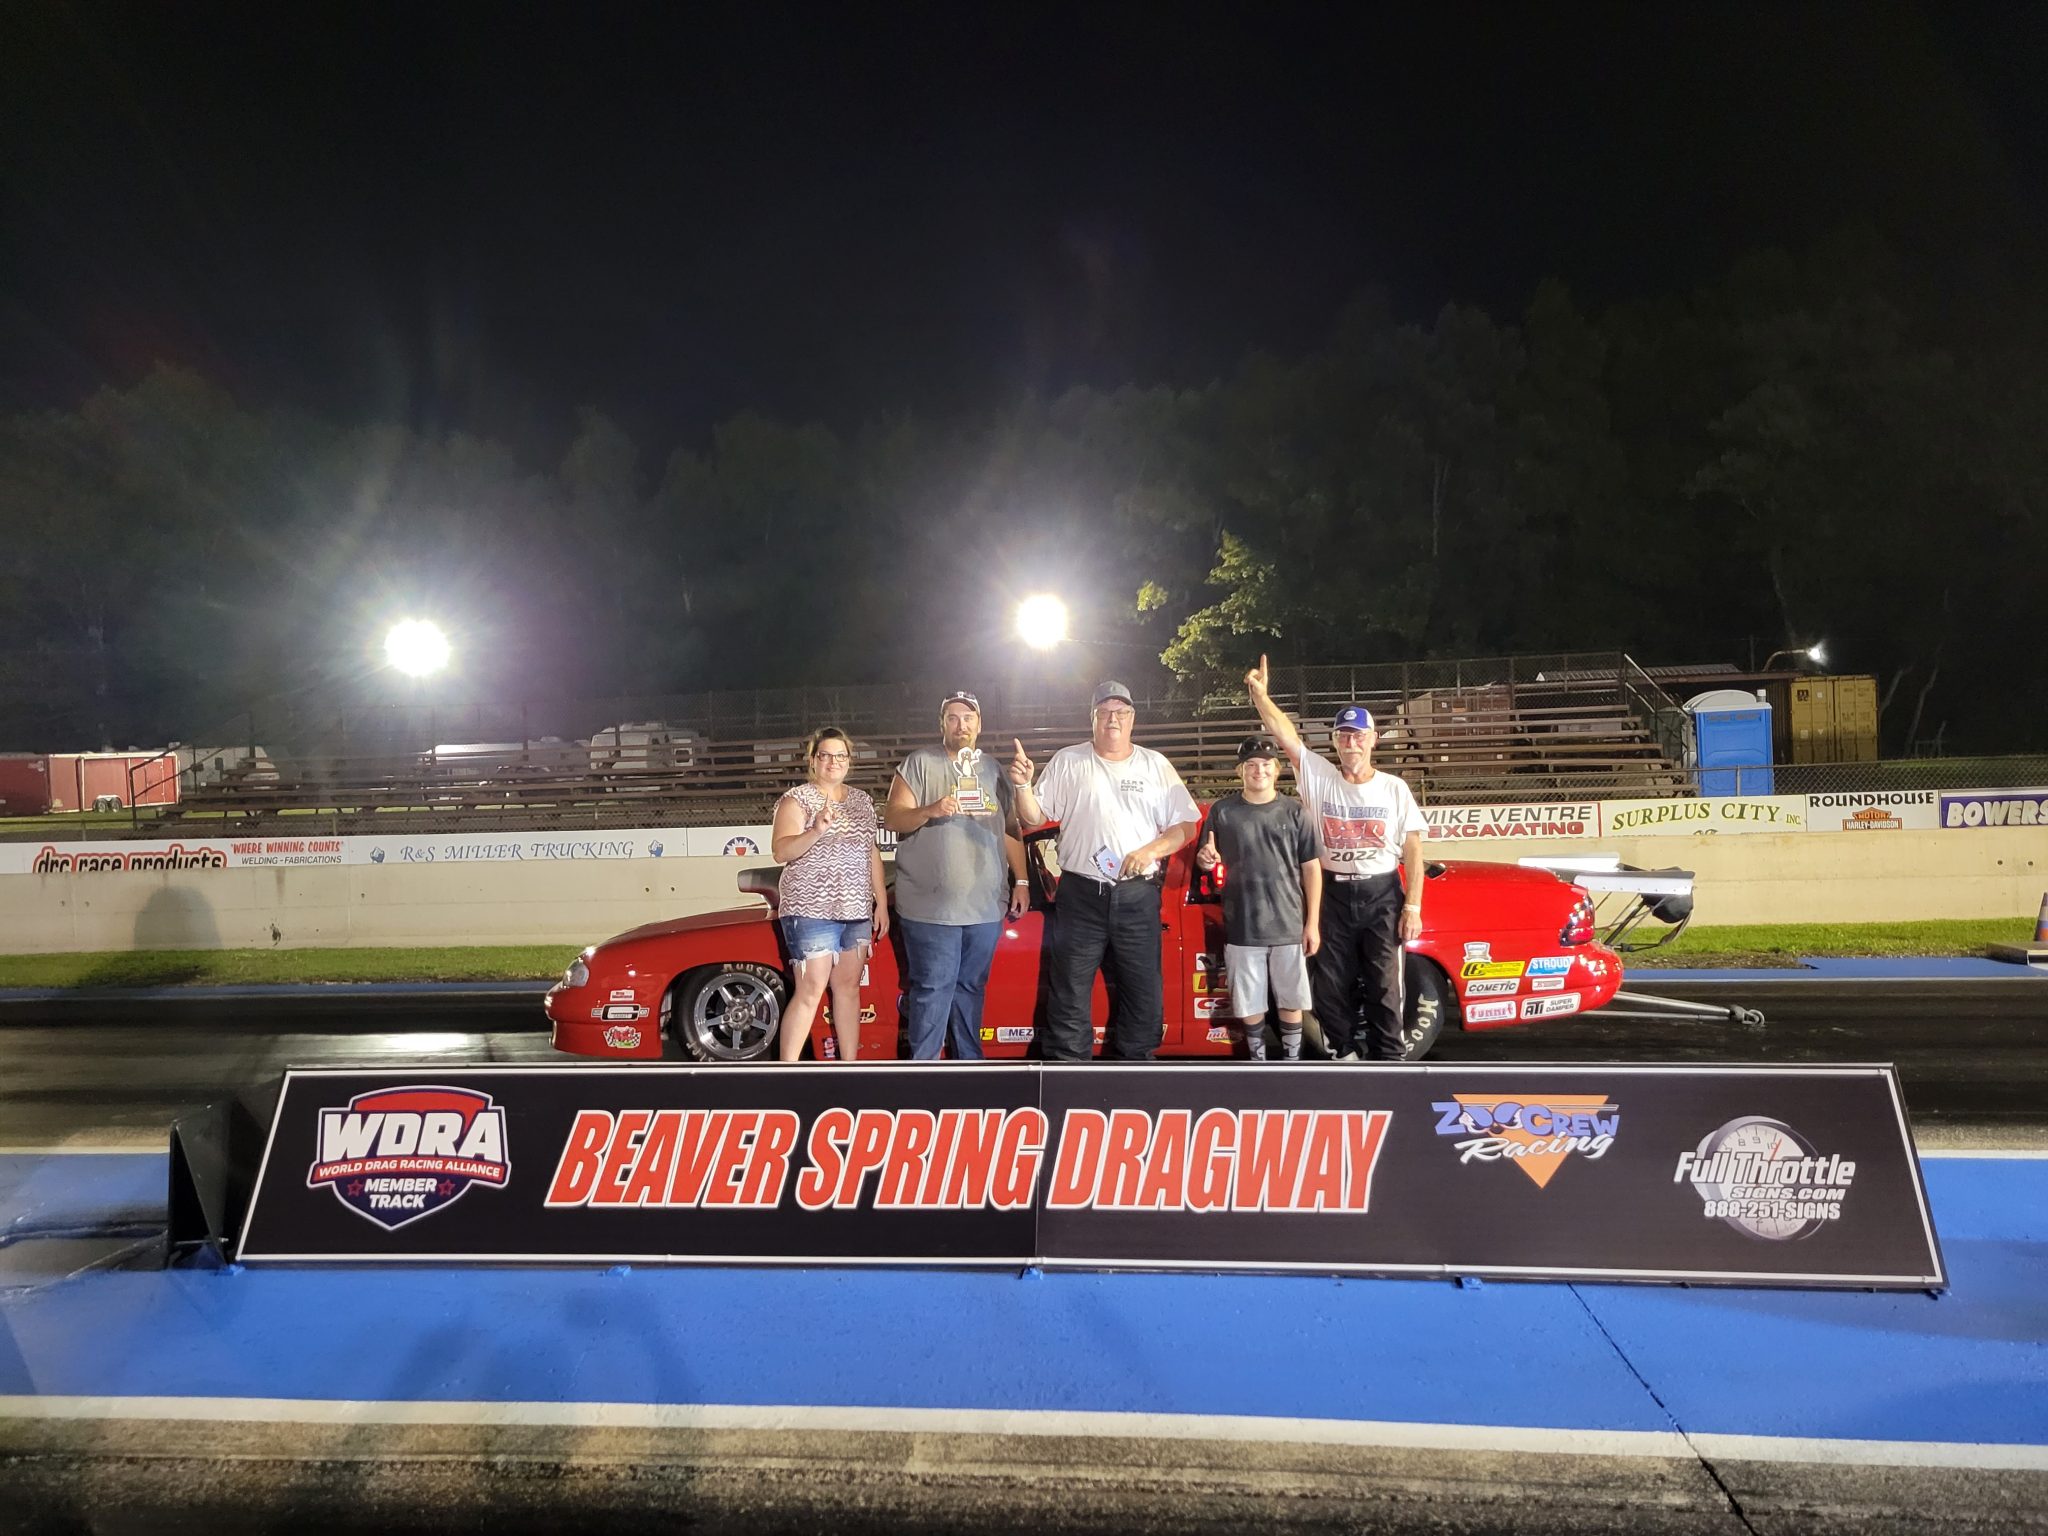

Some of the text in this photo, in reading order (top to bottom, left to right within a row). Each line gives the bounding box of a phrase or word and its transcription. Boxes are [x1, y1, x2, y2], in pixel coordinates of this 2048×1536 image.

[1809, 792, 1934, 807] ROUNDHOUSE
[1490, 806, 1592, 822] VENTRE
[1612, 803, 1710, 830] SURPLUS
[1721, 803, 1780, 822] CITY
[1427, 822, 1584, 838] EXCAVATING
[266, 842, 304, 853] WINNING
[400, 841, 634, 862] R&S MILLER TRUCKING
[241, 857, 278, 865] WELDING
[1331, 850, 1376, 862] 2022
[1532, 958, 1570, 970] STROUD
[1469, 982, 1517, 992] COMETIC
[1525, 1001, 1544, 1016] ATI
[322, 1112, 502, 1162] WDRA
[1454, 1132, 1614, 1165] Racing
[543, 1106, 1393, 1214] BEAVER SPRING DRAGWAY
[319, 1160, 500, 1177] WORLD DRAG RACING ALLIANCE
[364, 1178, 438, 1193] MEMBER
[1731, 1188, 1846, 1200] SIGNS.COM
[370, 1195, 425, 1209] TRACK
[1704, 1200, 1841, 1220] 888-251-SIGNS
